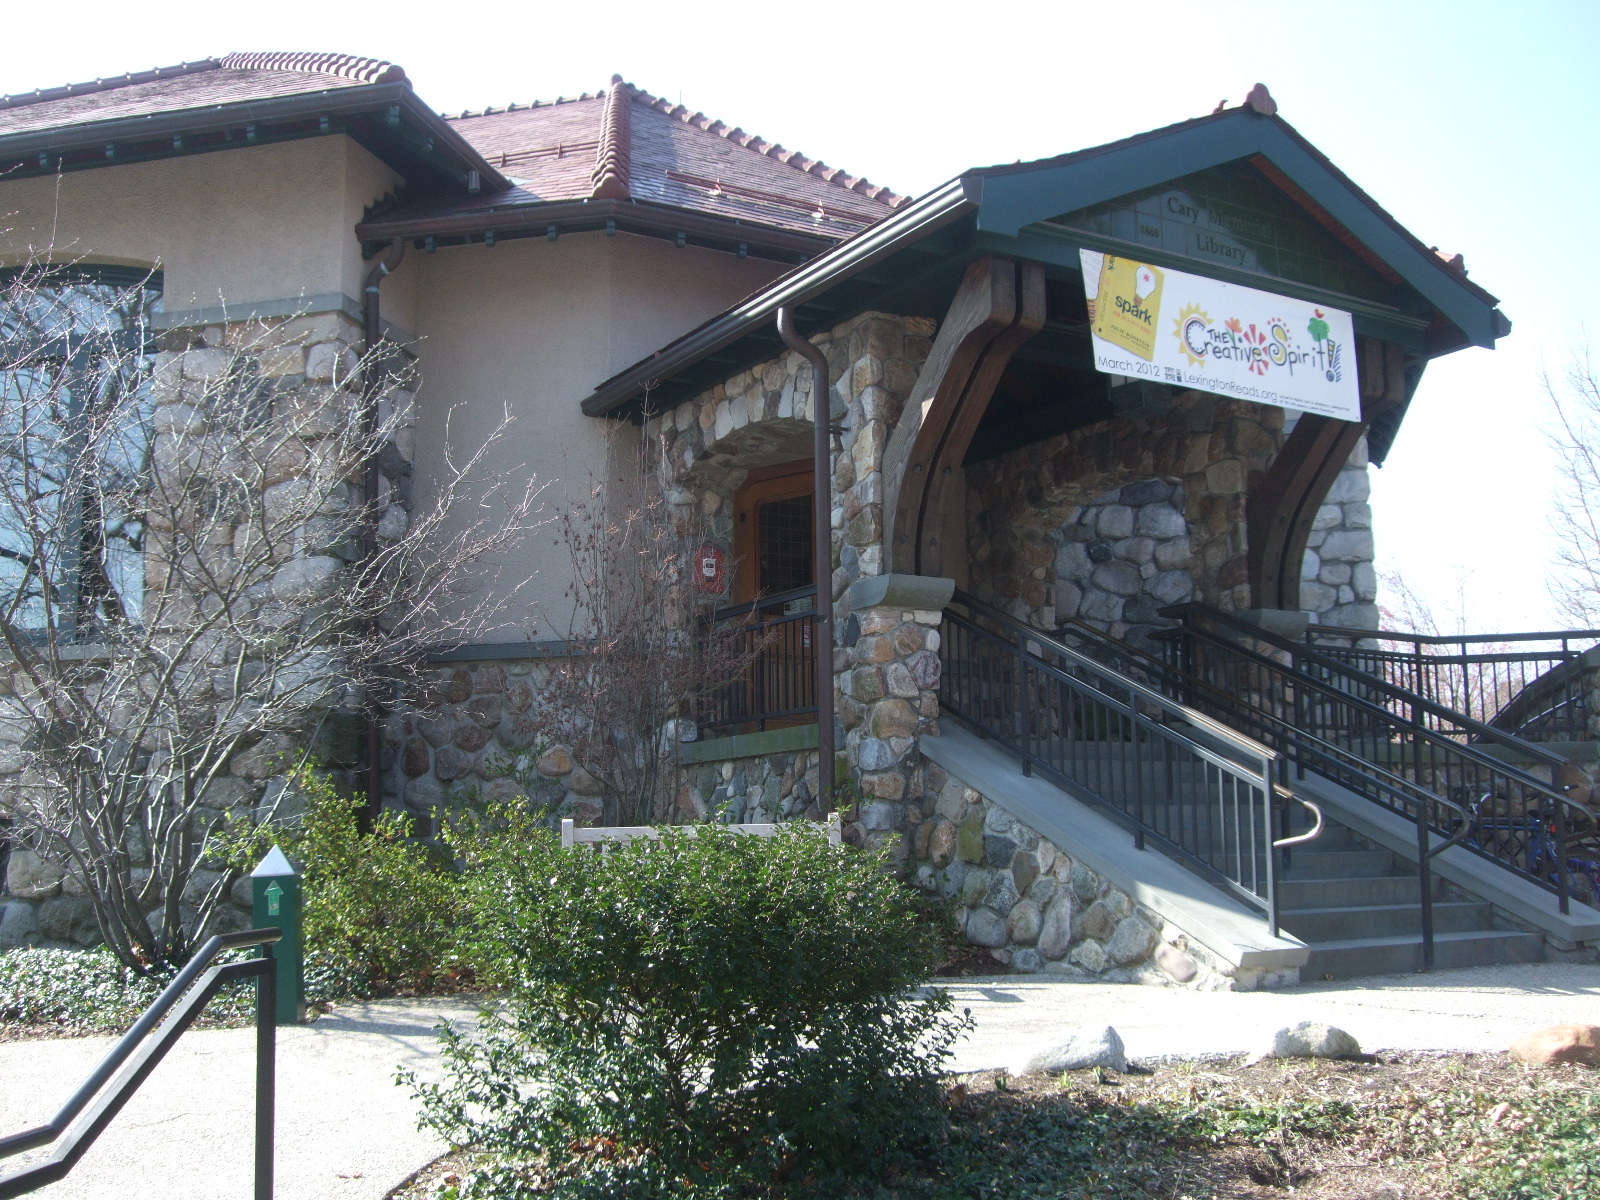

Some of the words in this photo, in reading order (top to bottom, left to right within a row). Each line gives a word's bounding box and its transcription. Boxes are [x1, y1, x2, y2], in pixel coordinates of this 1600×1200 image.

[1168, 197, 1200, 224] Cary
[1196, 233, 1245, 266] Library
[1115, 296, 1153, 326] spark
[1185, 319, 1263, 363] Creative
[1207, 328, 1229, 344] THE
[1098, 356, 1133, 372] March
[1136, 361, 1161, 377] 2012
[1184, 374, 1278, 403] LexingtonReads.org
